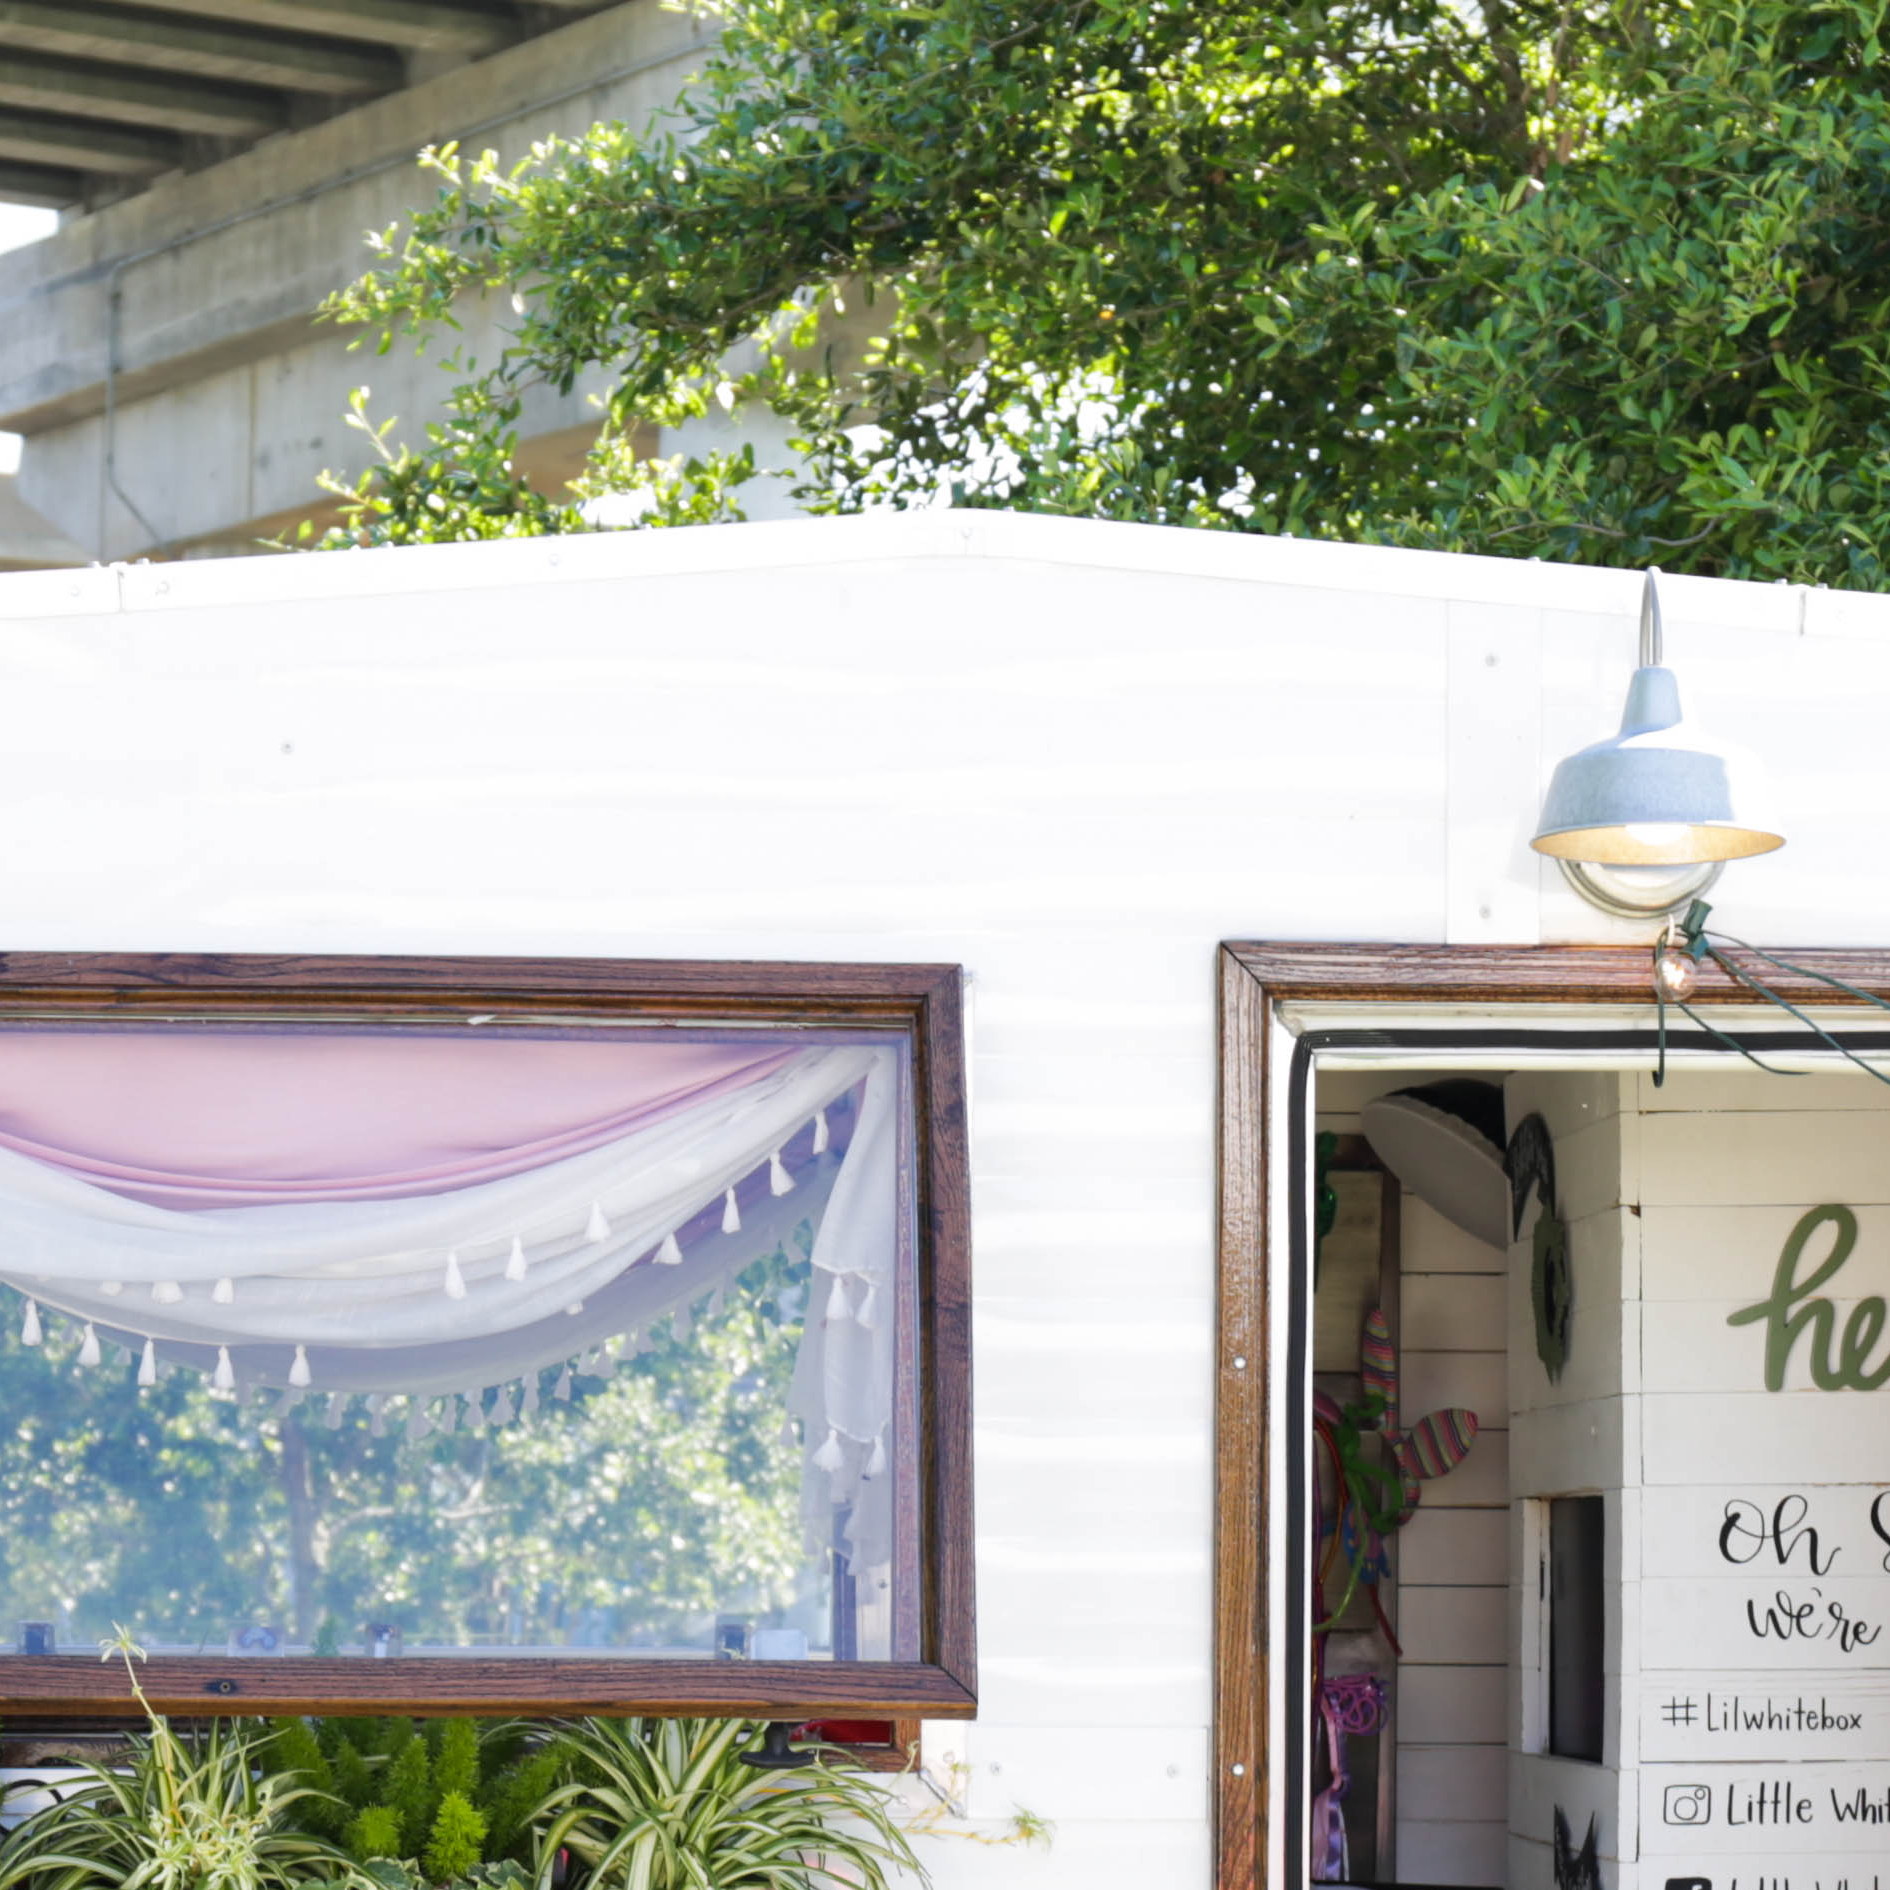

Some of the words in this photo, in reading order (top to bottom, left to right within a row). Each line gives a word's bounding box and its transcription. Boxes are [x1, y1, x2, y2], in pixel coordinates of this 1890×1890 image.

[1718, 1495, 1841, 1576] Oh
[1746, 1587, 1882, 1653] we're
[1661, 1693, 1862, 1732] #Lilwhitebox
[1727, 1781, 1813, 1825] Little
